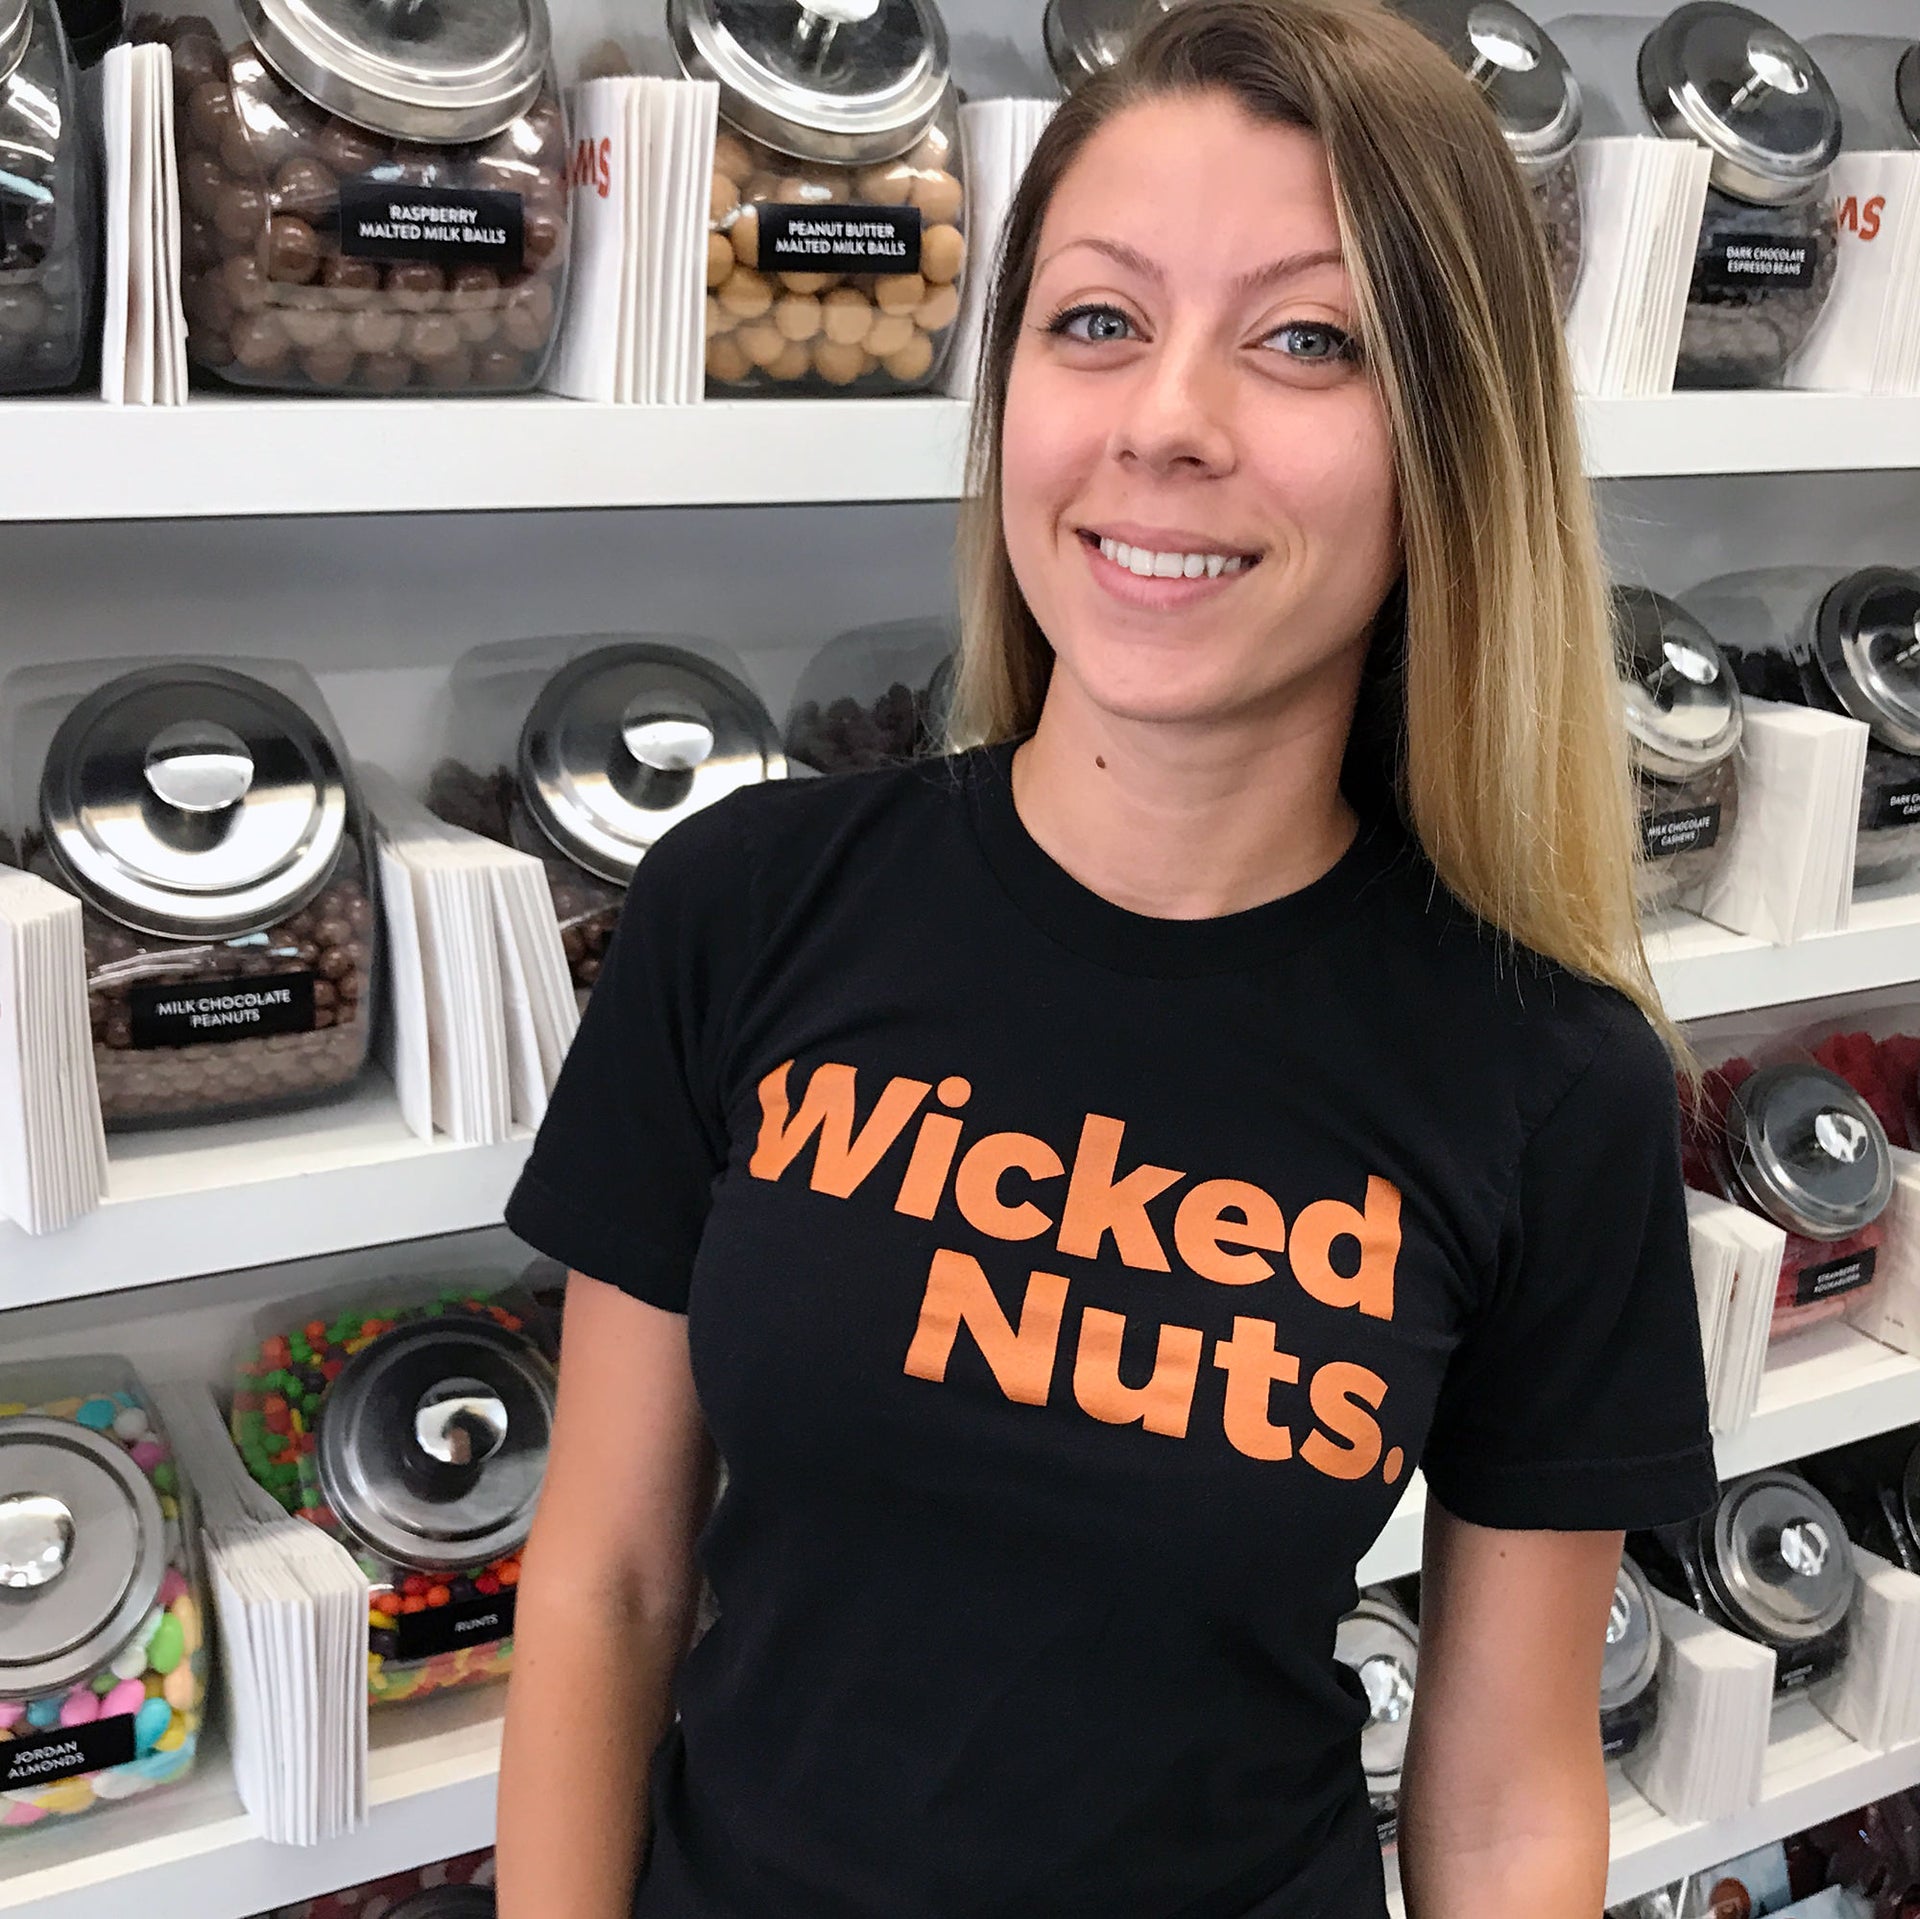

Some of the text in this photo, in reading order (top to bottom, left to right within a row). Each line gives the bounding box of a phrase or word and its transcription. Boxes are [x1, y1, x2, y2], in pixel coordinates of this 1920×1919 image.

[388, 203, 478, 224] RASPBERRY
[359, 221, 507, 244] MALTED MILK BALLS
[788, 219, 896, 239] PEANUT BUTTER
[775, 238, 907, 256] MALTED MILK BALLS
[1726, 245, 1806, 263] DARK CHOCOLATE
[1727, 259, 1801, 276] ESPRESSO BEANS
[1668, 815, 1711, 834] CHOCOLATE
[157, 989, 292, 1016] MILK CHOCOLATE
[191, 1008, 261, 1028] PEANUTS
[748, 1058, 1402, 1322] Wicked
[902, 1247, 1405, 1486] Nuts.
[454, 1613, 500, 1633] RUNTS
[12, 1740, 79, 1766] JORDAN
[6, 1751, 86, 1780] ALMONDS
